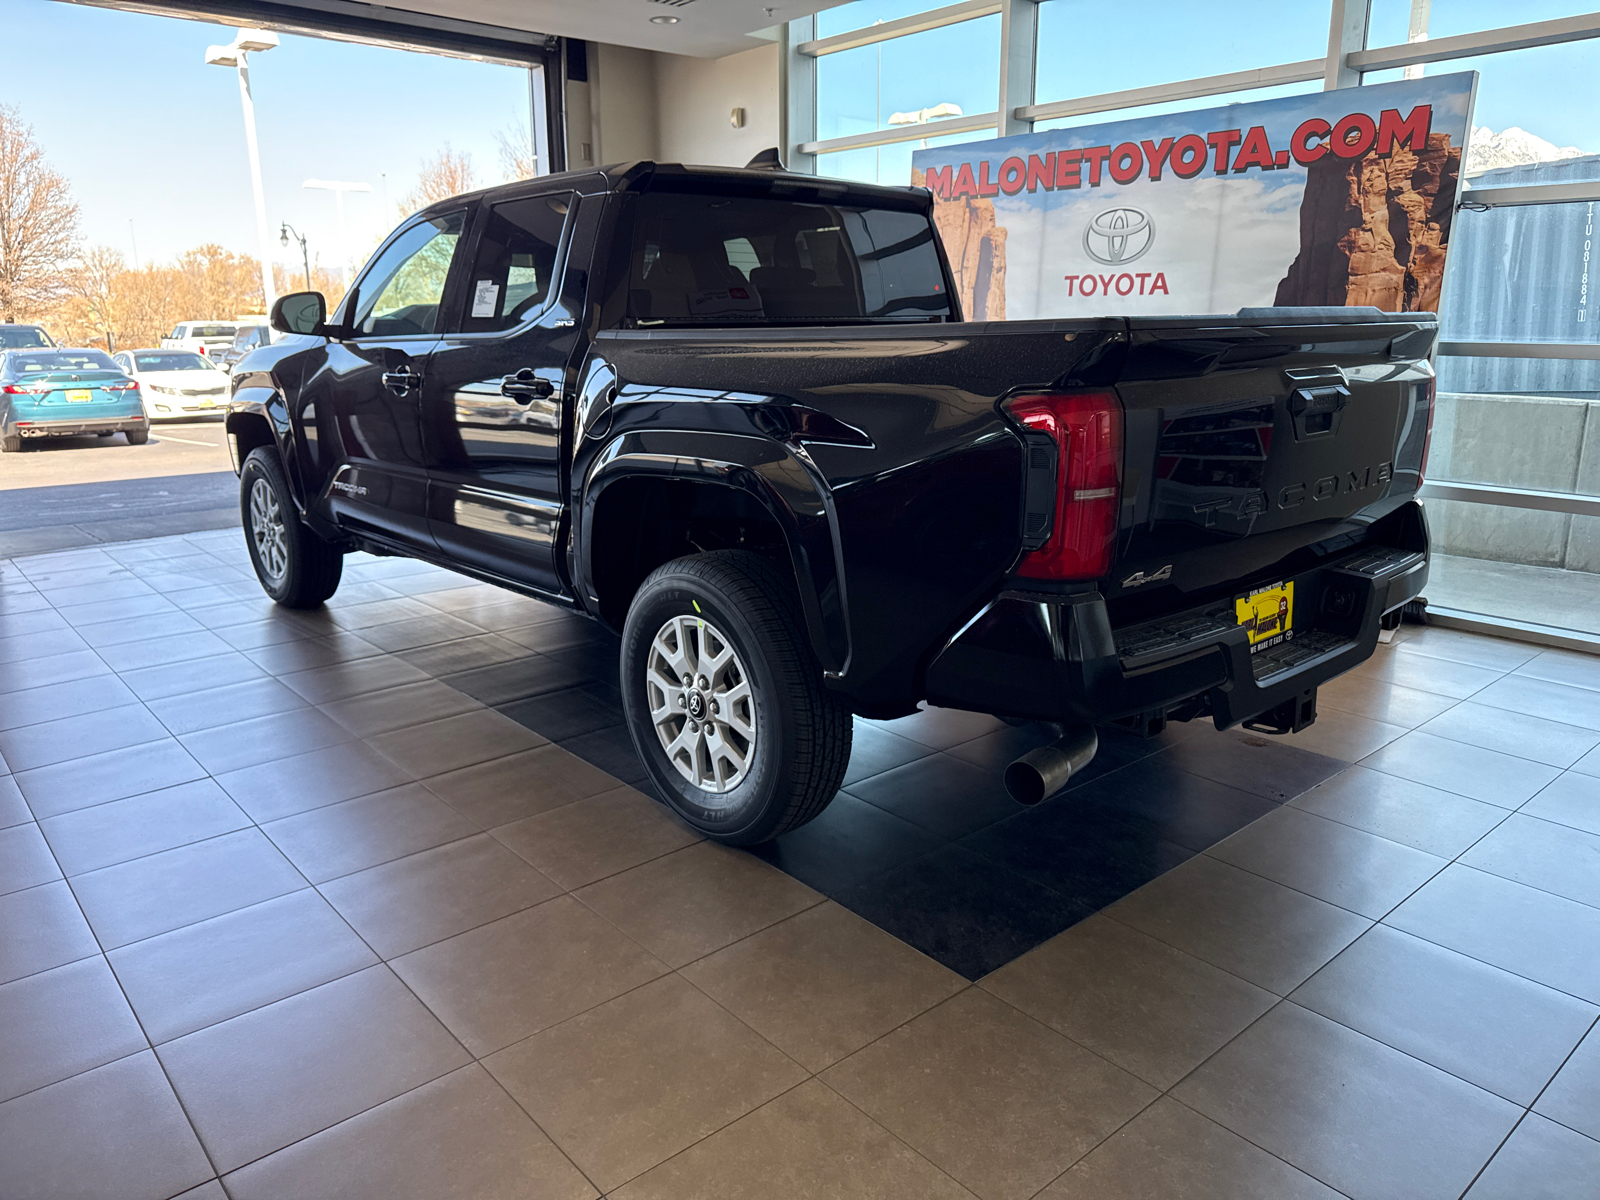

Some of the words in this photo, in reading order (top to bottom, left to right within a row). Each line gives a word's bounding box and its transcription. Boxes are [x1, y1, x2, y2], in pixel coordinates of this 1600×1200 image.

[926, 104, 1433, 202] MALONETOYOTA.COM
[1064, 272, 1169, 297] TOYOTA
[1193, 460, 1394, 527] TACOMA
[1280, 601, 1287, 611] 32
